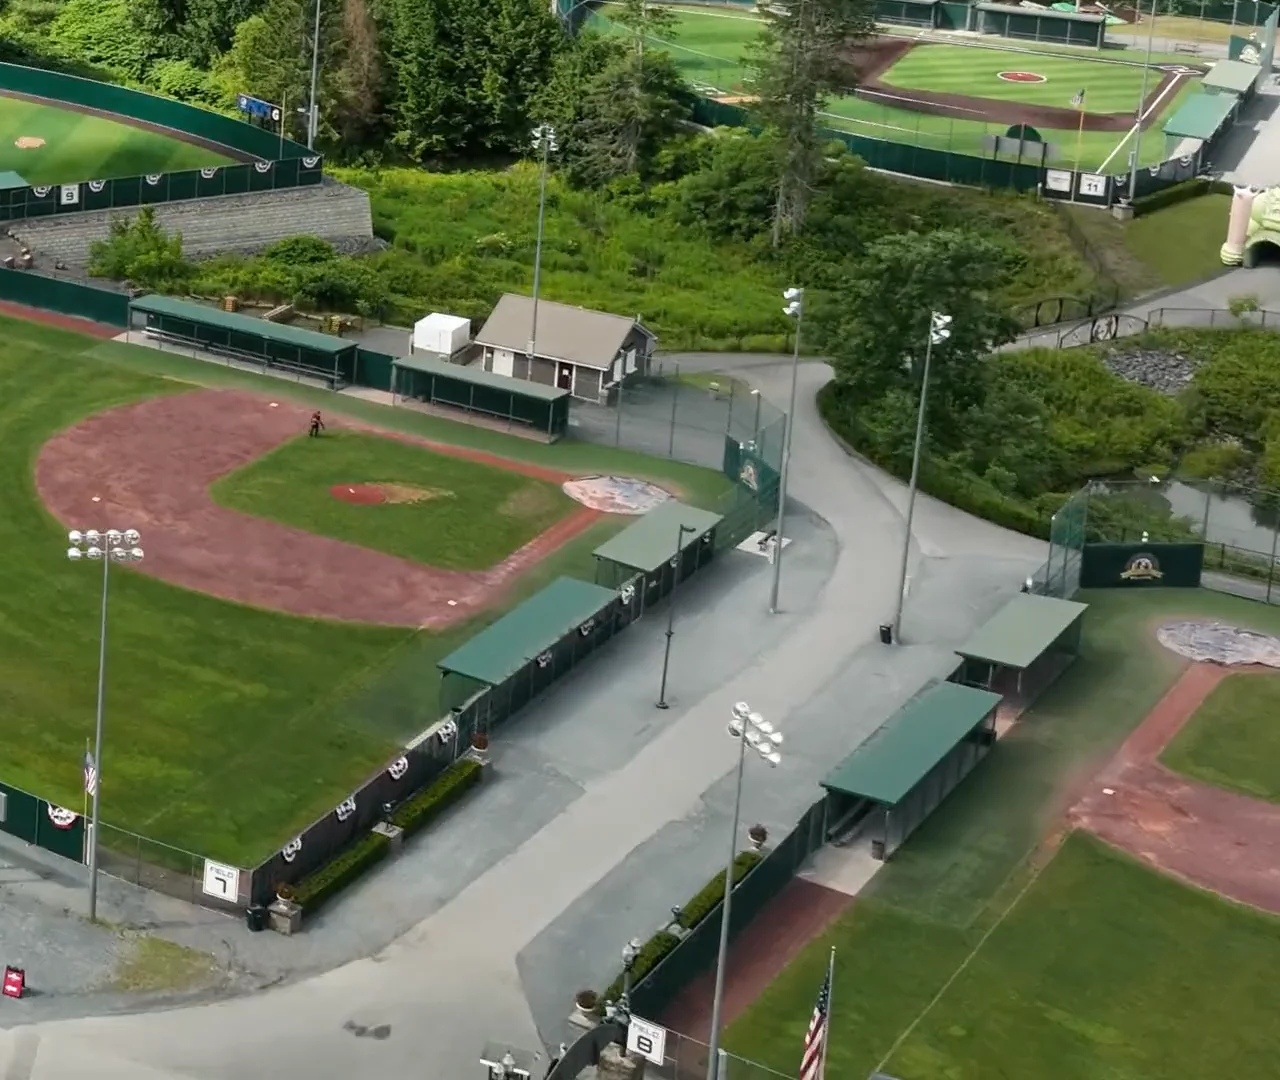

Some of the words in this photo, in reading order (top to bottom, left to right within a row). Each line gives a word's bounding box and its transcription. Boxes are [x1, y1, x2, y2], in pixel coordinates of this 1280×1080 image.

[66, 191, 74, 200] 9
[210, 866, 234, 879] FIELD
[214, 876, 227, 893] 7
[637, 1035, 652, 1053] 8
